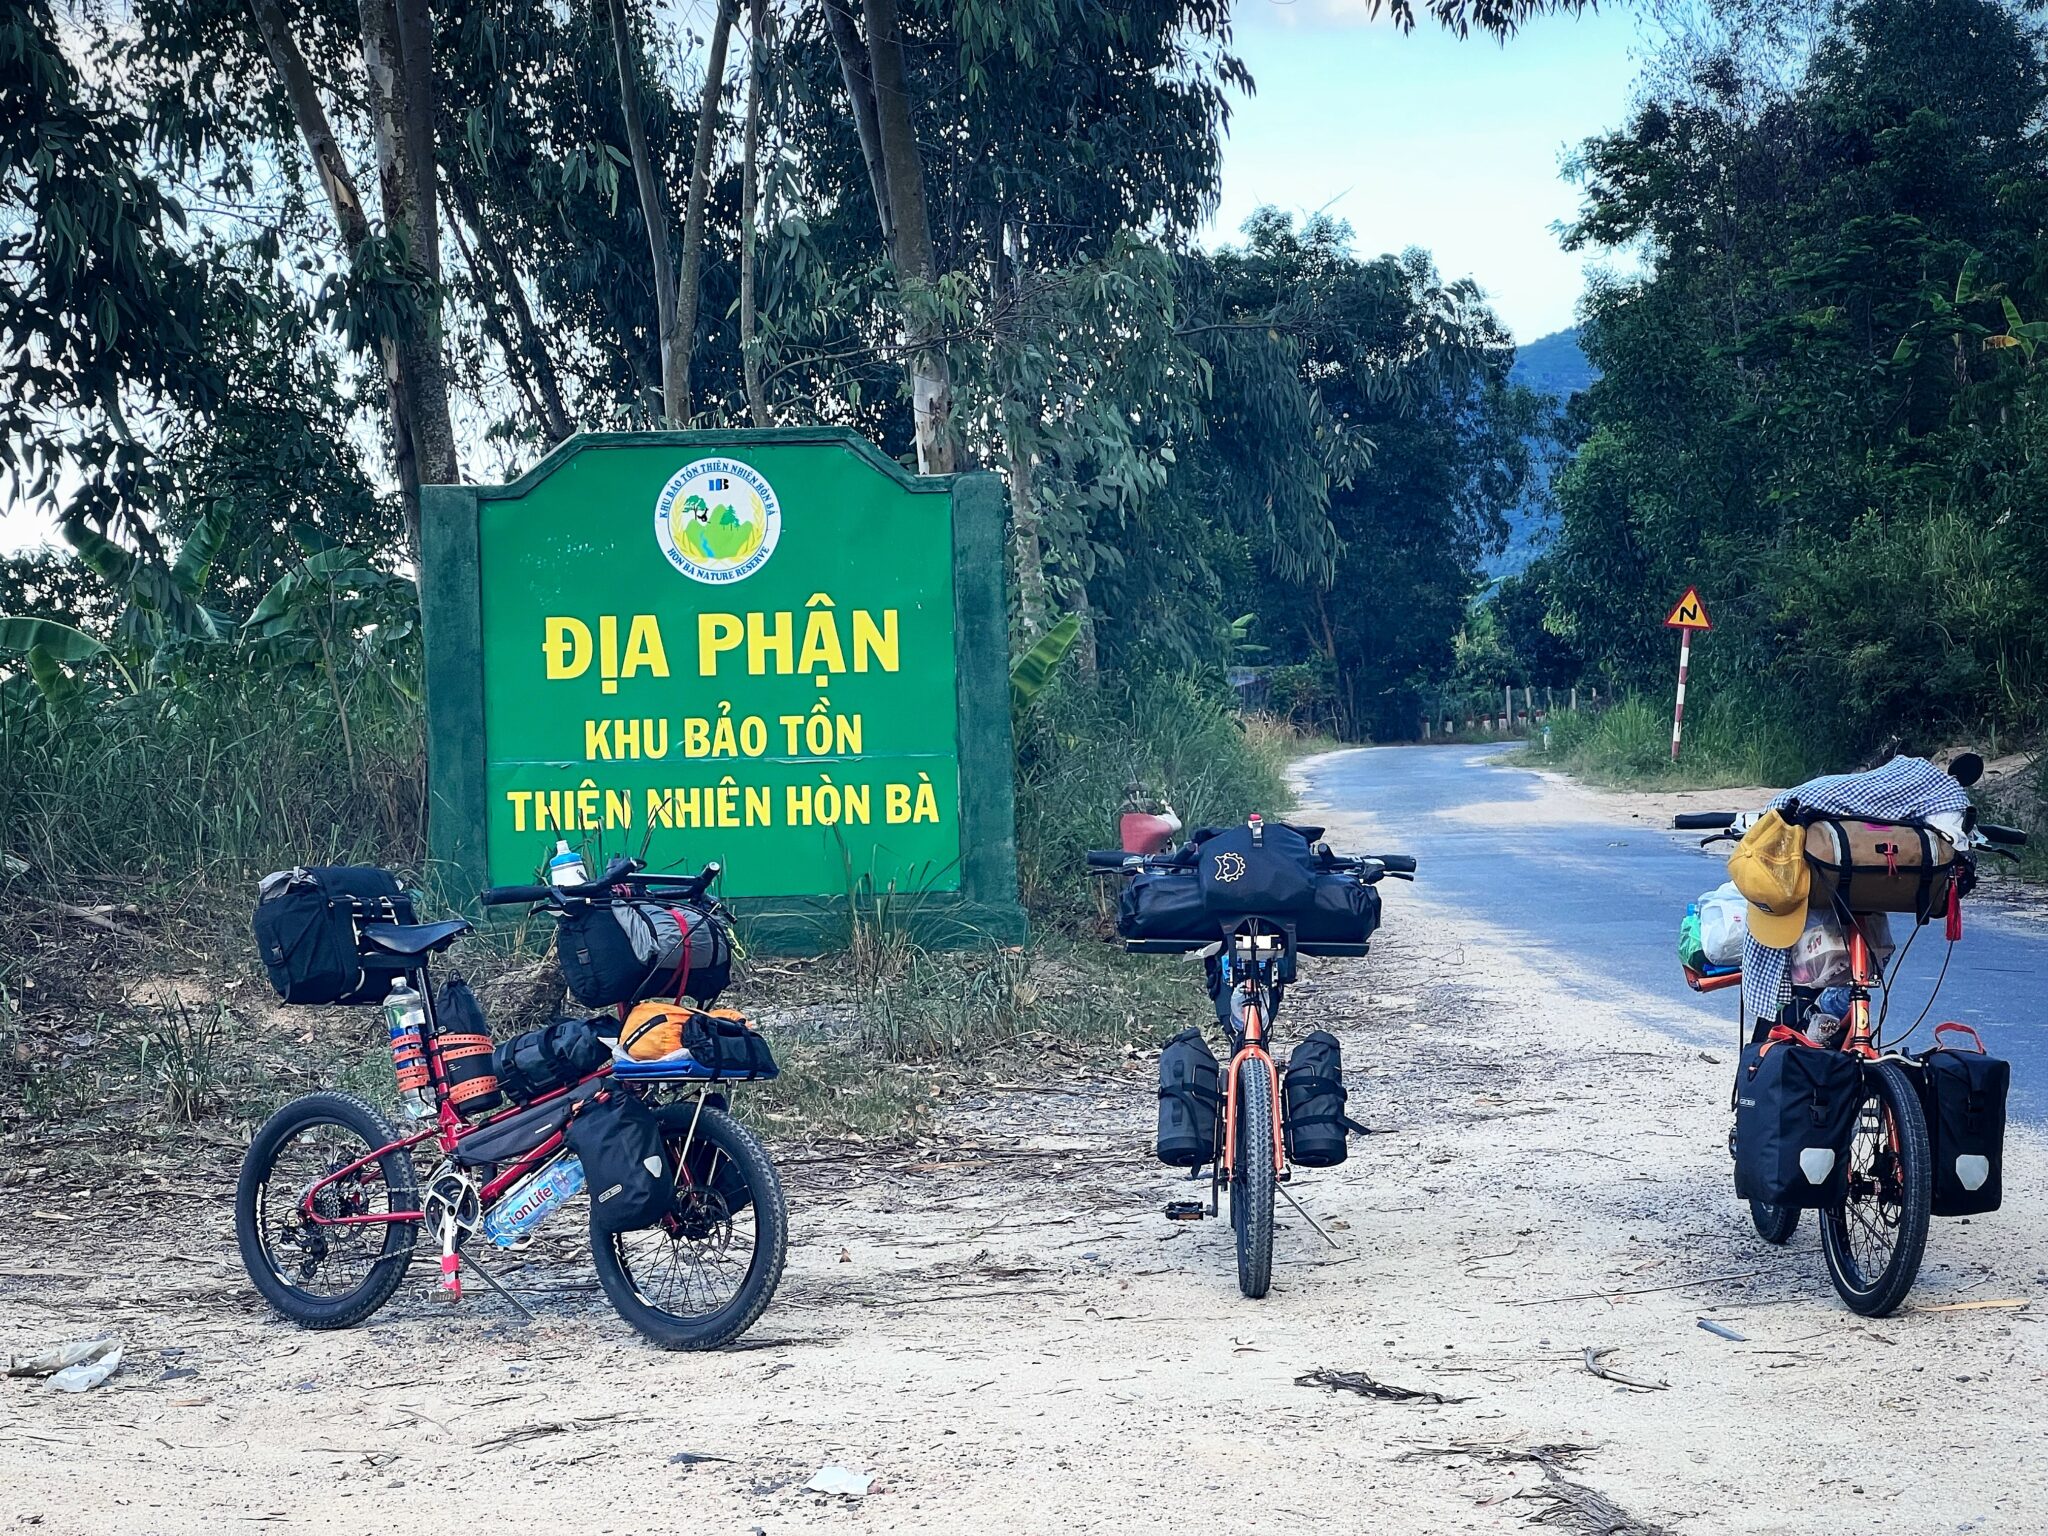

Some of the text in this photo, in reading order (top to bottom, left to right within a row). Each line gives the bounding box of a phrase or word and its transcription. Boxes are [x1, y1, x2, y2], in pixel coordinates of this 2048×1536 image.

[660, 498, 671, 518] KHU
[667, 546, 770, 581] HON BA NATURE RESERVE
[542, 593, 900, 694] ĐỊA PHẬN
[585, 697, 862, 760] KHU BẢO TỒN
[506, 772, 939, 832] THIÊN NHIÊN HÒN BÀ
[528, 1187, 553, 1208] Life
